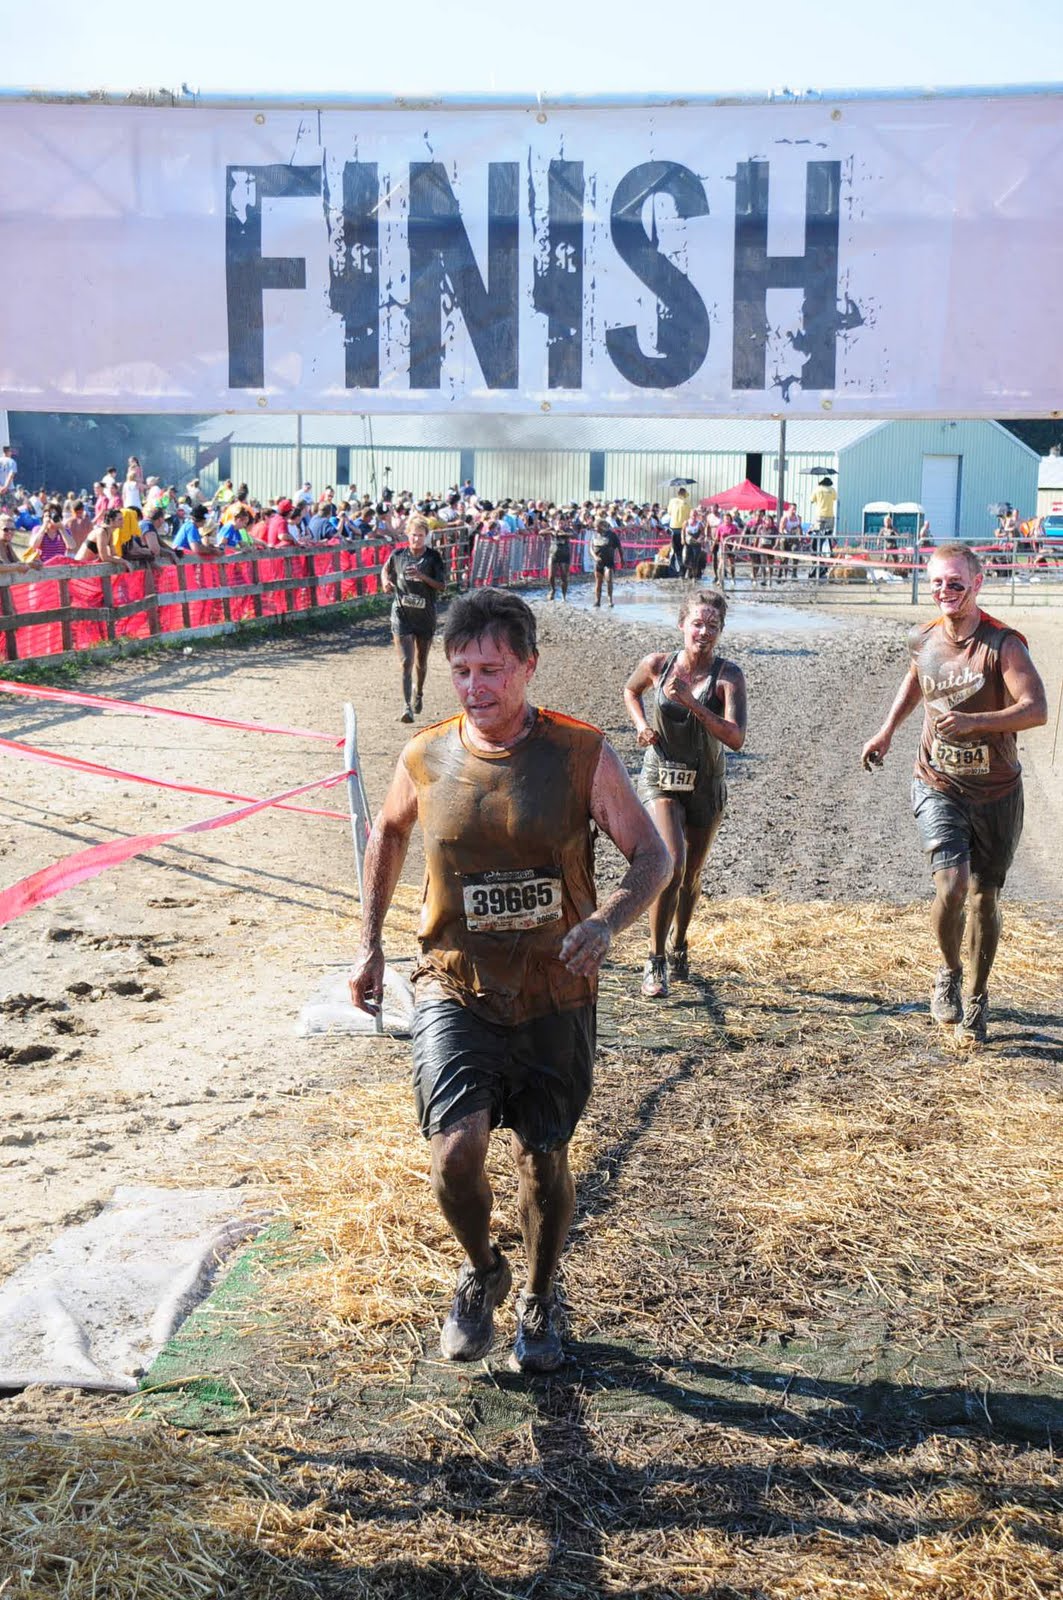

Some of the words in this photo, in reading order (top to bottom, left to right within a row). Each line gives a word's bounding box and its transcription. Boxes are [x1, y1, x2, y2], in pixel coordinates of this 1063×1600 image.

[225, 160, 842, 391] FINISH
[921, 667, 984, 695] Dutch
[472, 882, 553, 917] 39665
